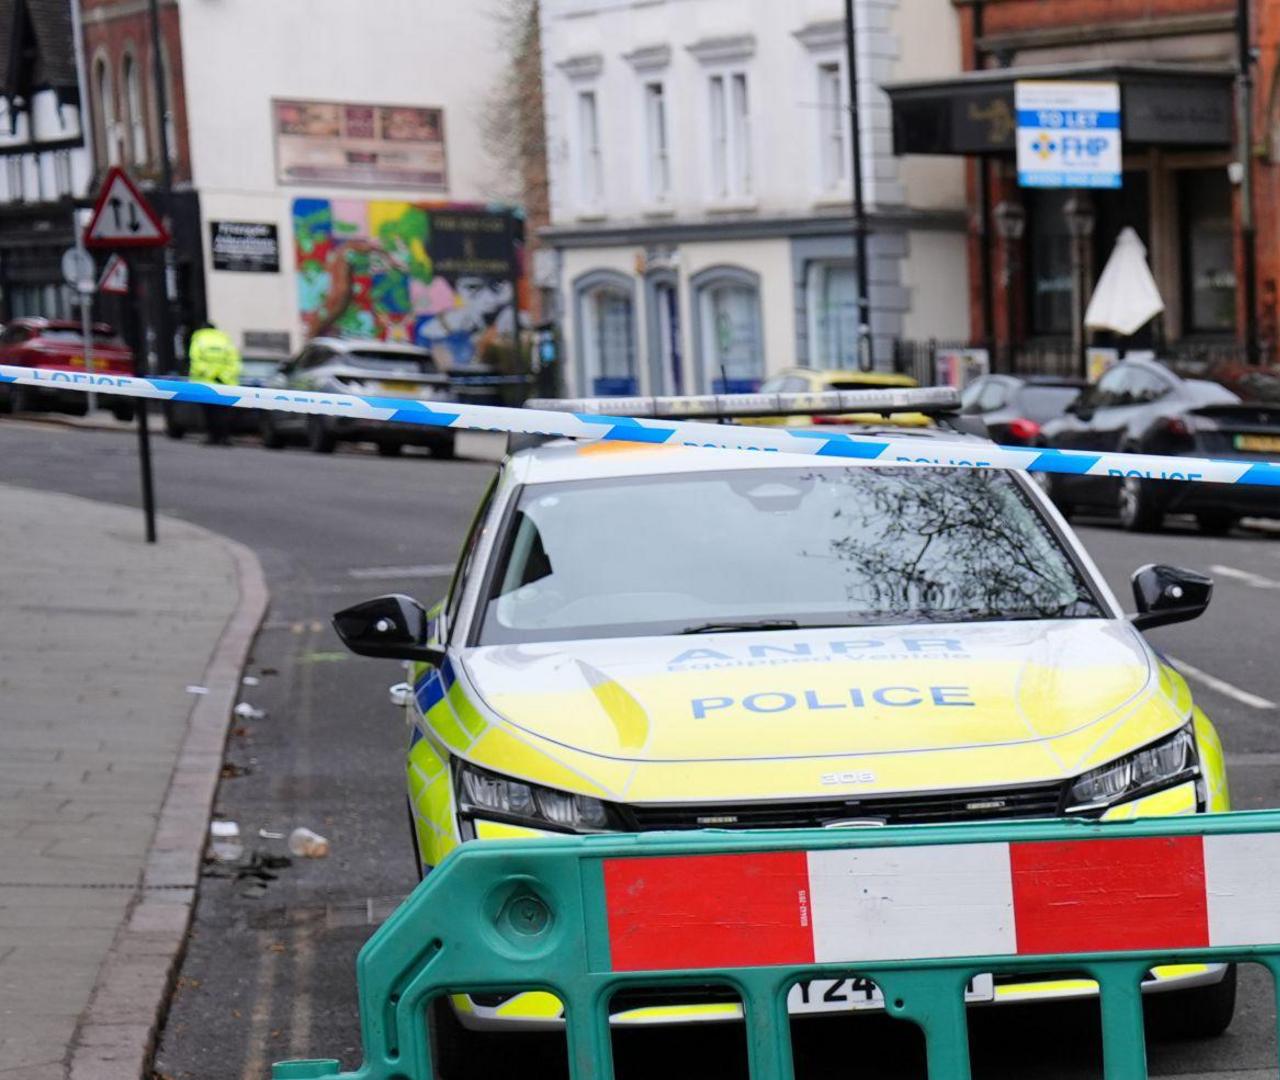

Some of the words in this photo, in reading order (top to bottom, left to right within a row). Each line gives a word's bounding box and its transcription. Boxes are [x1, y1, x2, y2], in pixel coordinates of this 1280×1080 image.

[1036, 111, 1063, 128] TO
[1066, 111, 1097, 128] LET
[1062, 136, 1109, 157] FHP
[667, 638, 964, 664] ANPR
[667, 653, 831, 672] Equipped
[847, 648, 971, 662] Vehicle
[691, 686, 976, 719] POLICE
[820, 769, 875, 785] 308
